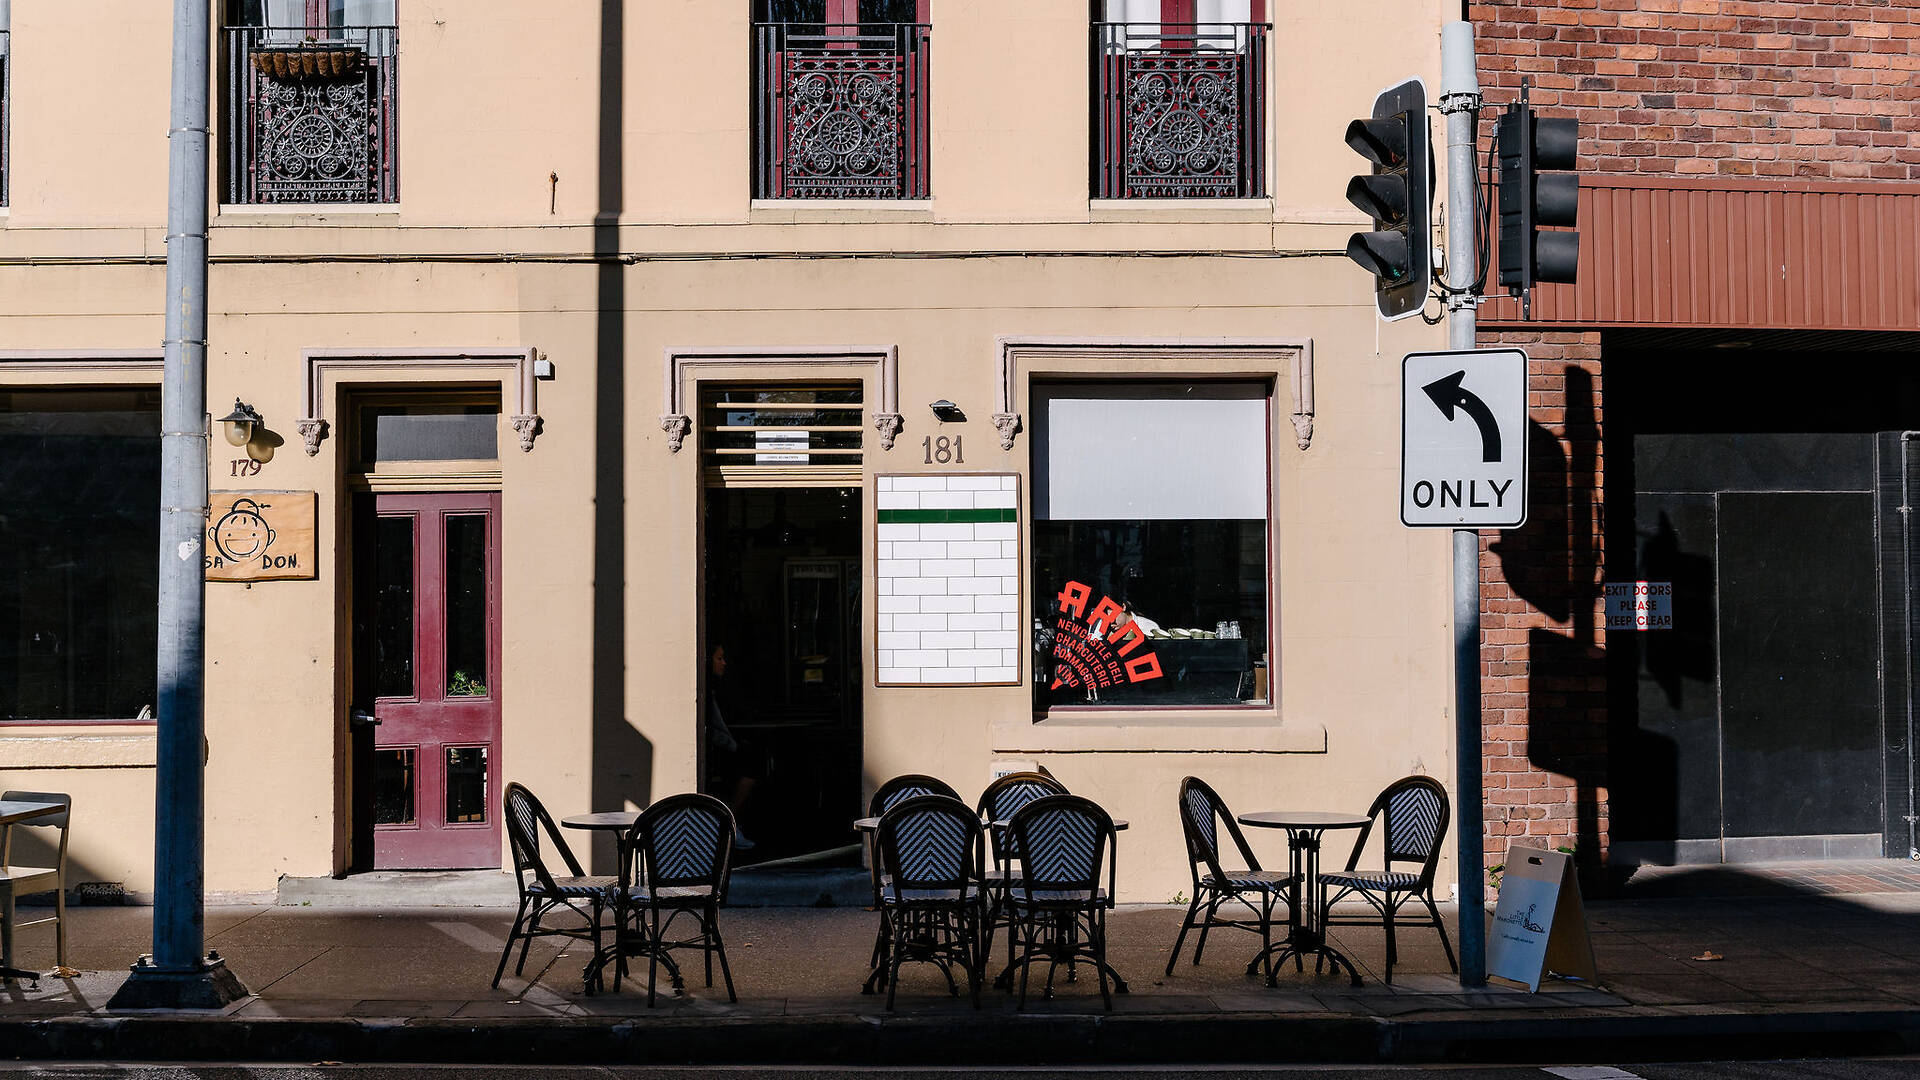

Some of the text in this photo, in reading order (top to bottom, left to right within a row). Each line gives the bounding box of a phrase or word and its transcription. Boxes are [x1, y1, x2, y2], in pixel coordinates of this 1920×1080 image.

[922, 435, 964, 464] 181
[230, 459, 262, 476] 179
[1413, 479, 1513, 508] ONLY
[1606, 585, 1671, 596] EXIT DOORS
[1621, 600, 1657, 611] PLEASE
[1058, 580, 1163, 683] ARNO
[1608, 616, 1671, 626] KEEP CLEAR
[1056, 632, 1111, 688] CHARCUTERIE
[1057, 618, 1124, 685] NEWCASTLE DELI
[1053, 646, 1097, 690] FORMAGGIO
[1057, 664, 1079, 688] VINO
